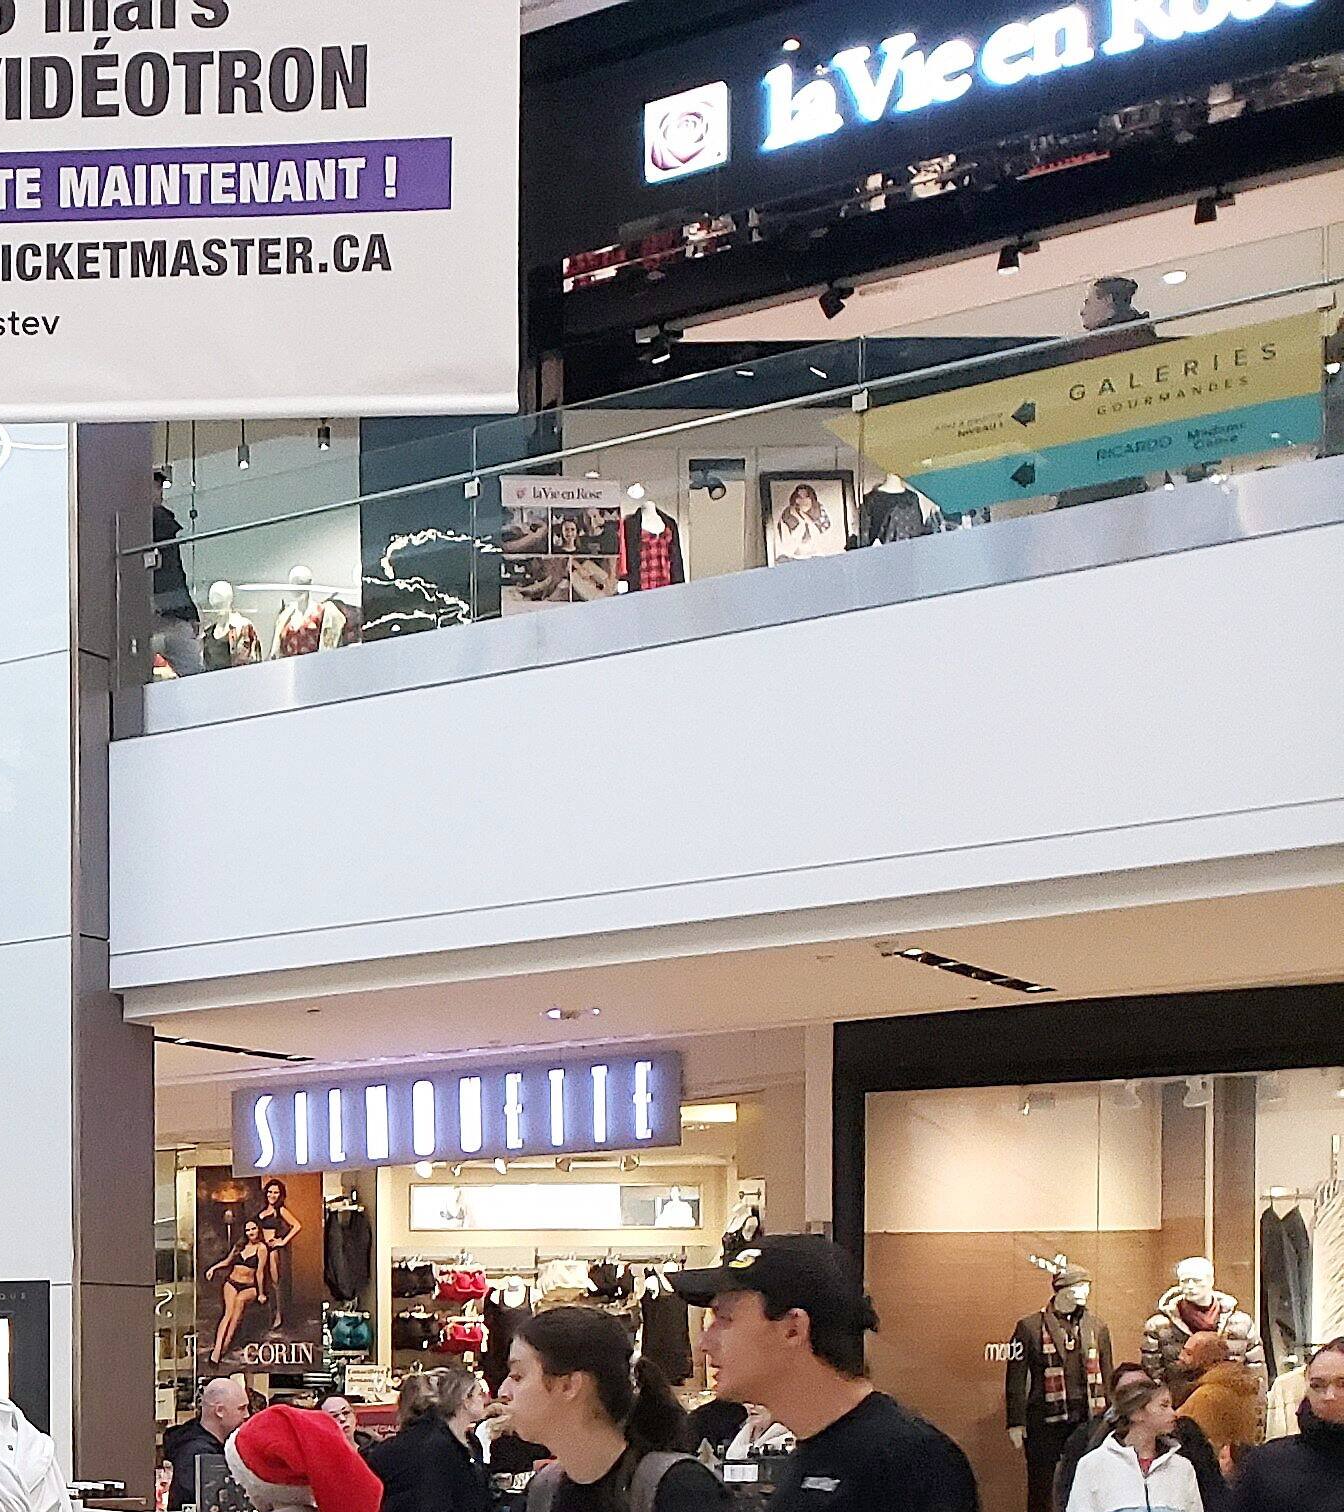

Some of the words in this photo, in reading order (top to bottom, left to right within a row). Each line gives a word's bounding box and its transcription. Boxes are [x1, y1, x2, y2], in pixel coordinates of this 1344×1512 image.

[43, 0, 230, 33] mars
[762, 62, 846, 152] la
[830, 31, 976, 122] Vie
[982, 4, 1095, 85] en
[1100, 0, 1317, 55] Ro
[58, 156, 368, 209] MAINTENANT
[383, 156, 398, 199] !
[1068, 342, 1278, 402] GALERIES
[1096, 375, 1249, 416] GOURMANDES
[253, 1059, 653, 1168] SILHOUETTE
[242, 1342, 314, 1366] CORIN
